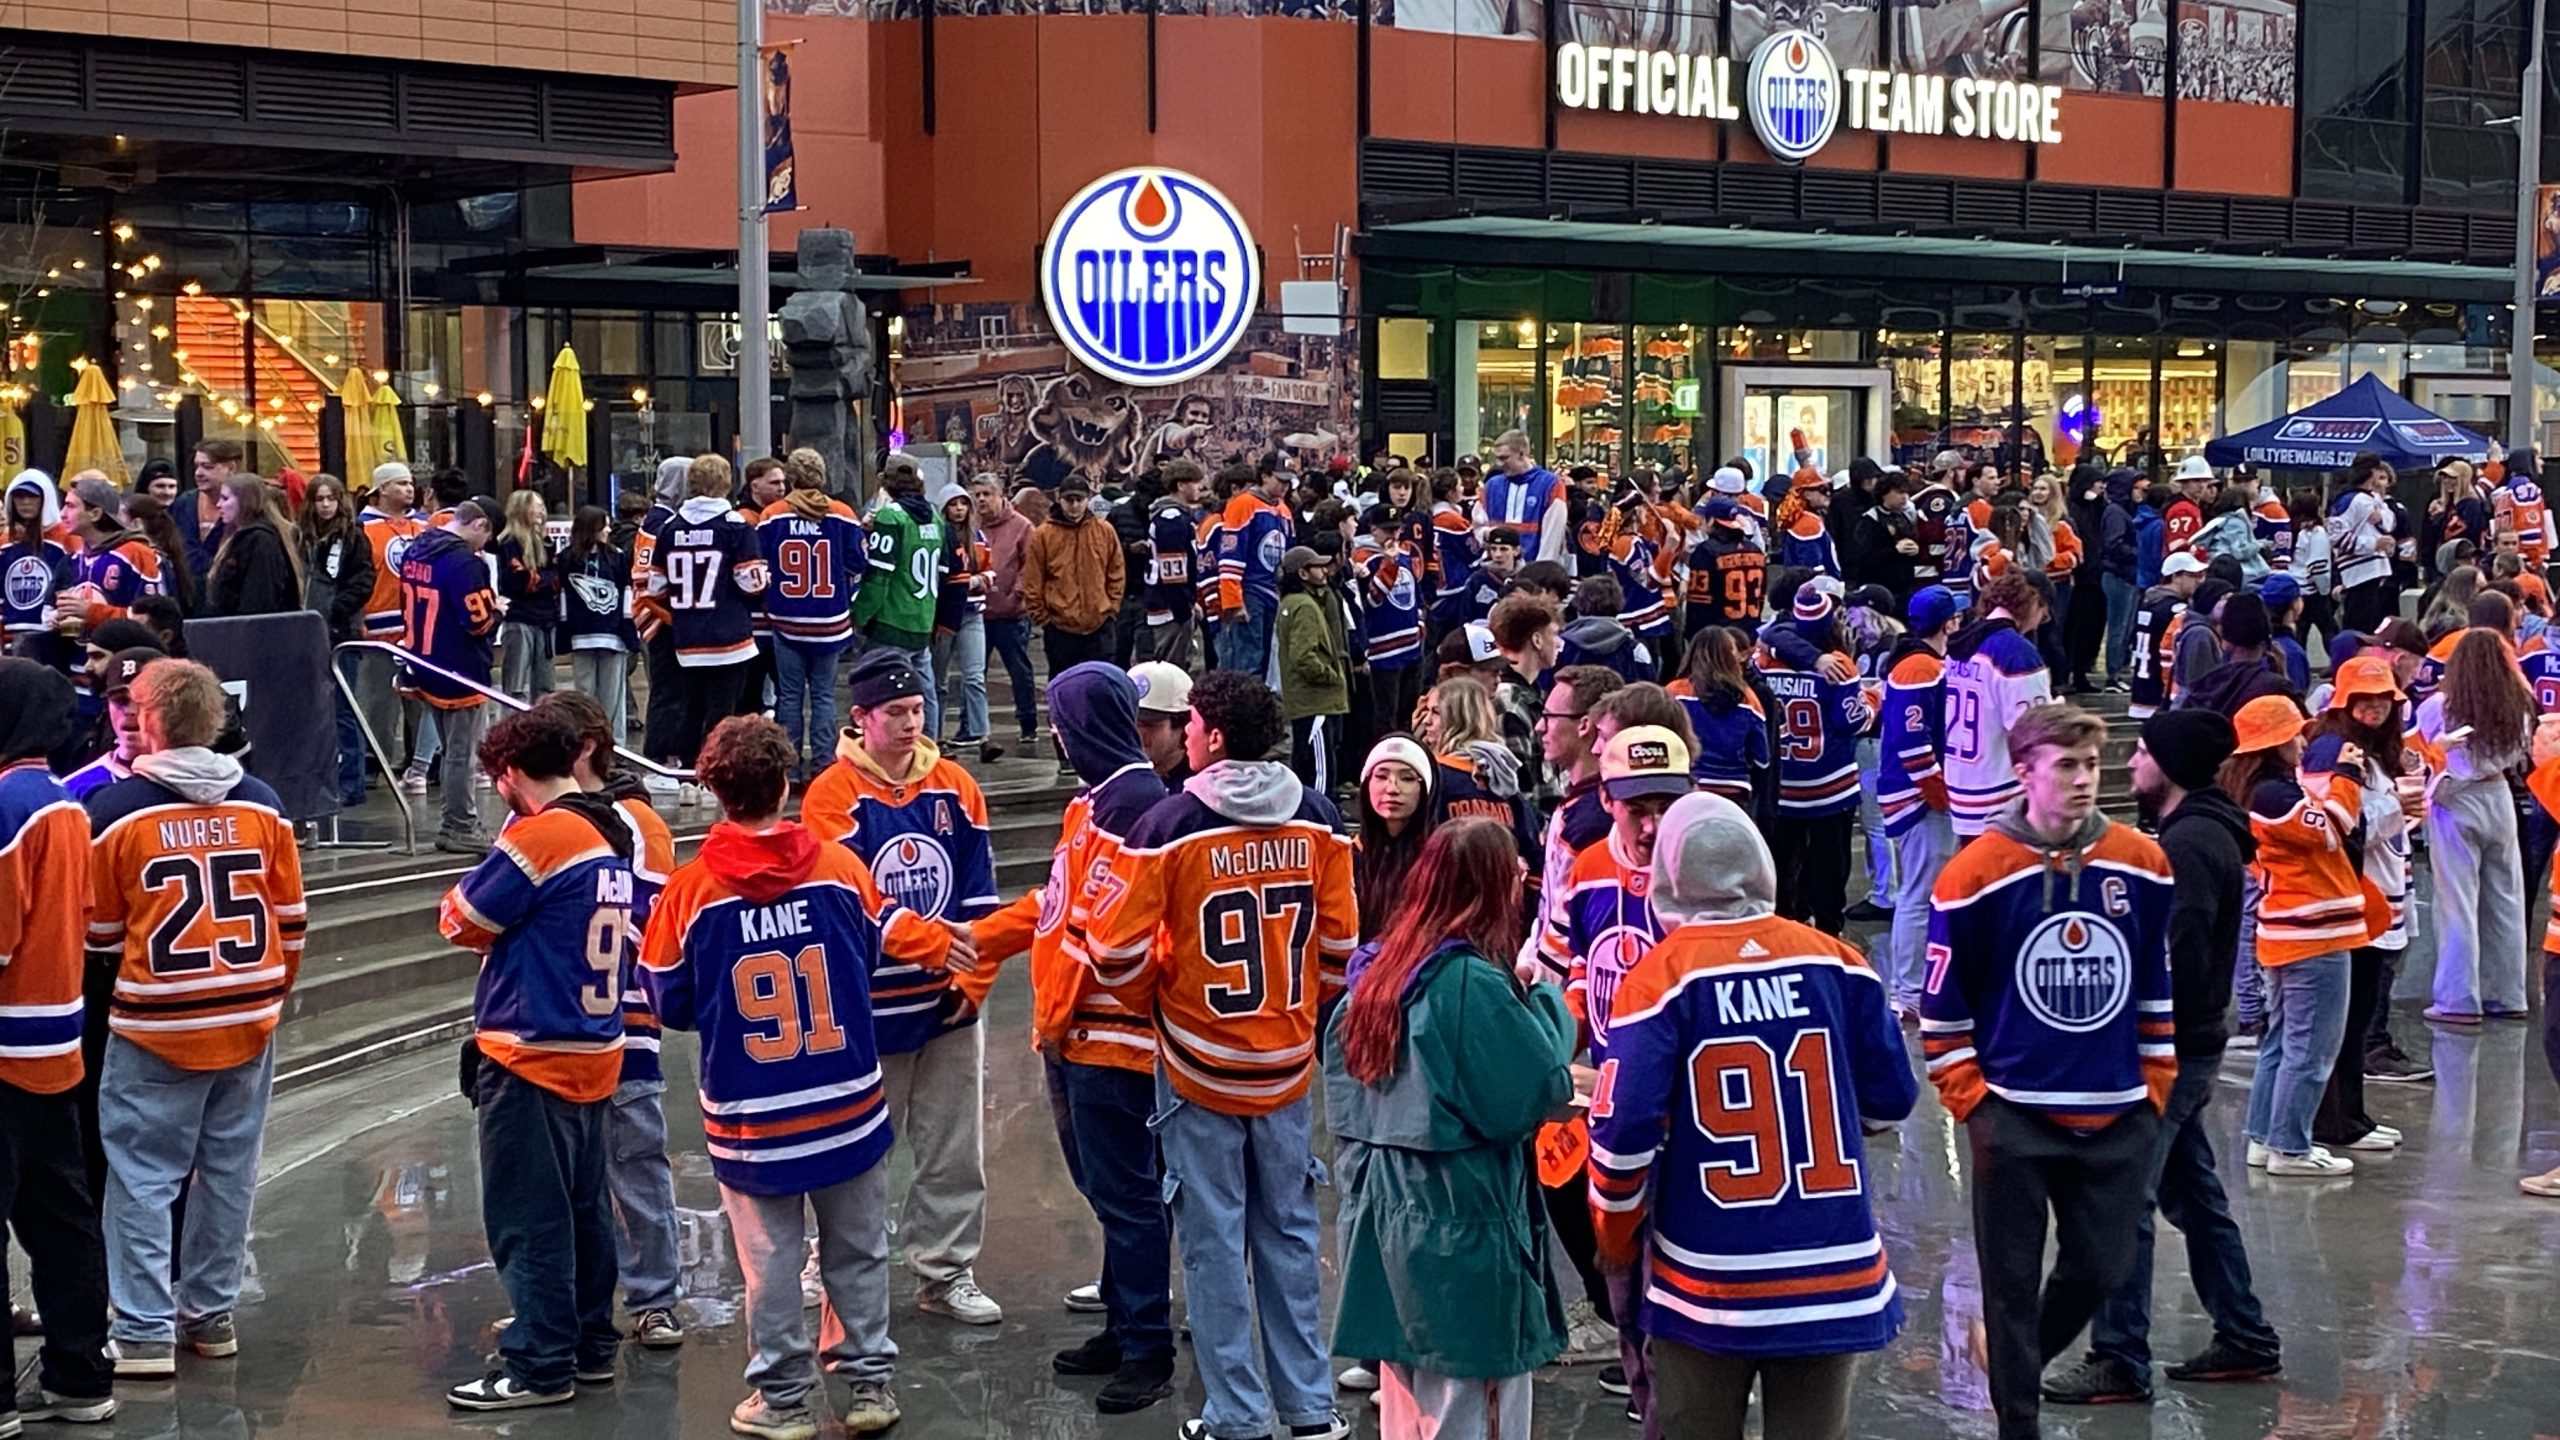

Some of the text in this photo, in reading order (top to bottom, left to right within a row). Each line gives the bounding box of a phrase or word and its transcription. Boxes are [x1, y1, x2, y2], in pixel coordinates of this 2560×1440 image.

[1558, 41, 1740, 121] OFFICIAL
[1844, 67, 2062, 144] TEAM STORE
[1271, 381, 1291, 399] FAN
[1293, 384, 1319, 402] DECK
[2243, 447, 2358, 467] LOILTYREWARDS.CO
[789, 519, 823, 536] KANE
[869, 531, 894, 554] 90
[2169, 516, 2192, 533] 97
[666, 550, 723, 609] 97
[779, 539, 835, 599] 91
[1162, 560, 1184, 578] 93
[1723, 568, 1764, 619] 93
[1905, 705, 1924, 732] 2
[158, 815, 240, 851] NURSE
[934, 799, 954, 836] A
[1209, 837, 1311, 879] McDAVID
[140, 848, 267, 976] 25
[2101, 876, 2131, 918] C
[740, 901, 812, 943] KANE
[1199, 880, 1317, 1019] 97
[731, 944, 847, 1063] 91
[1714, 973, 1810, 1025] KANE
[1687, 1028, 1863, 1209] 91
